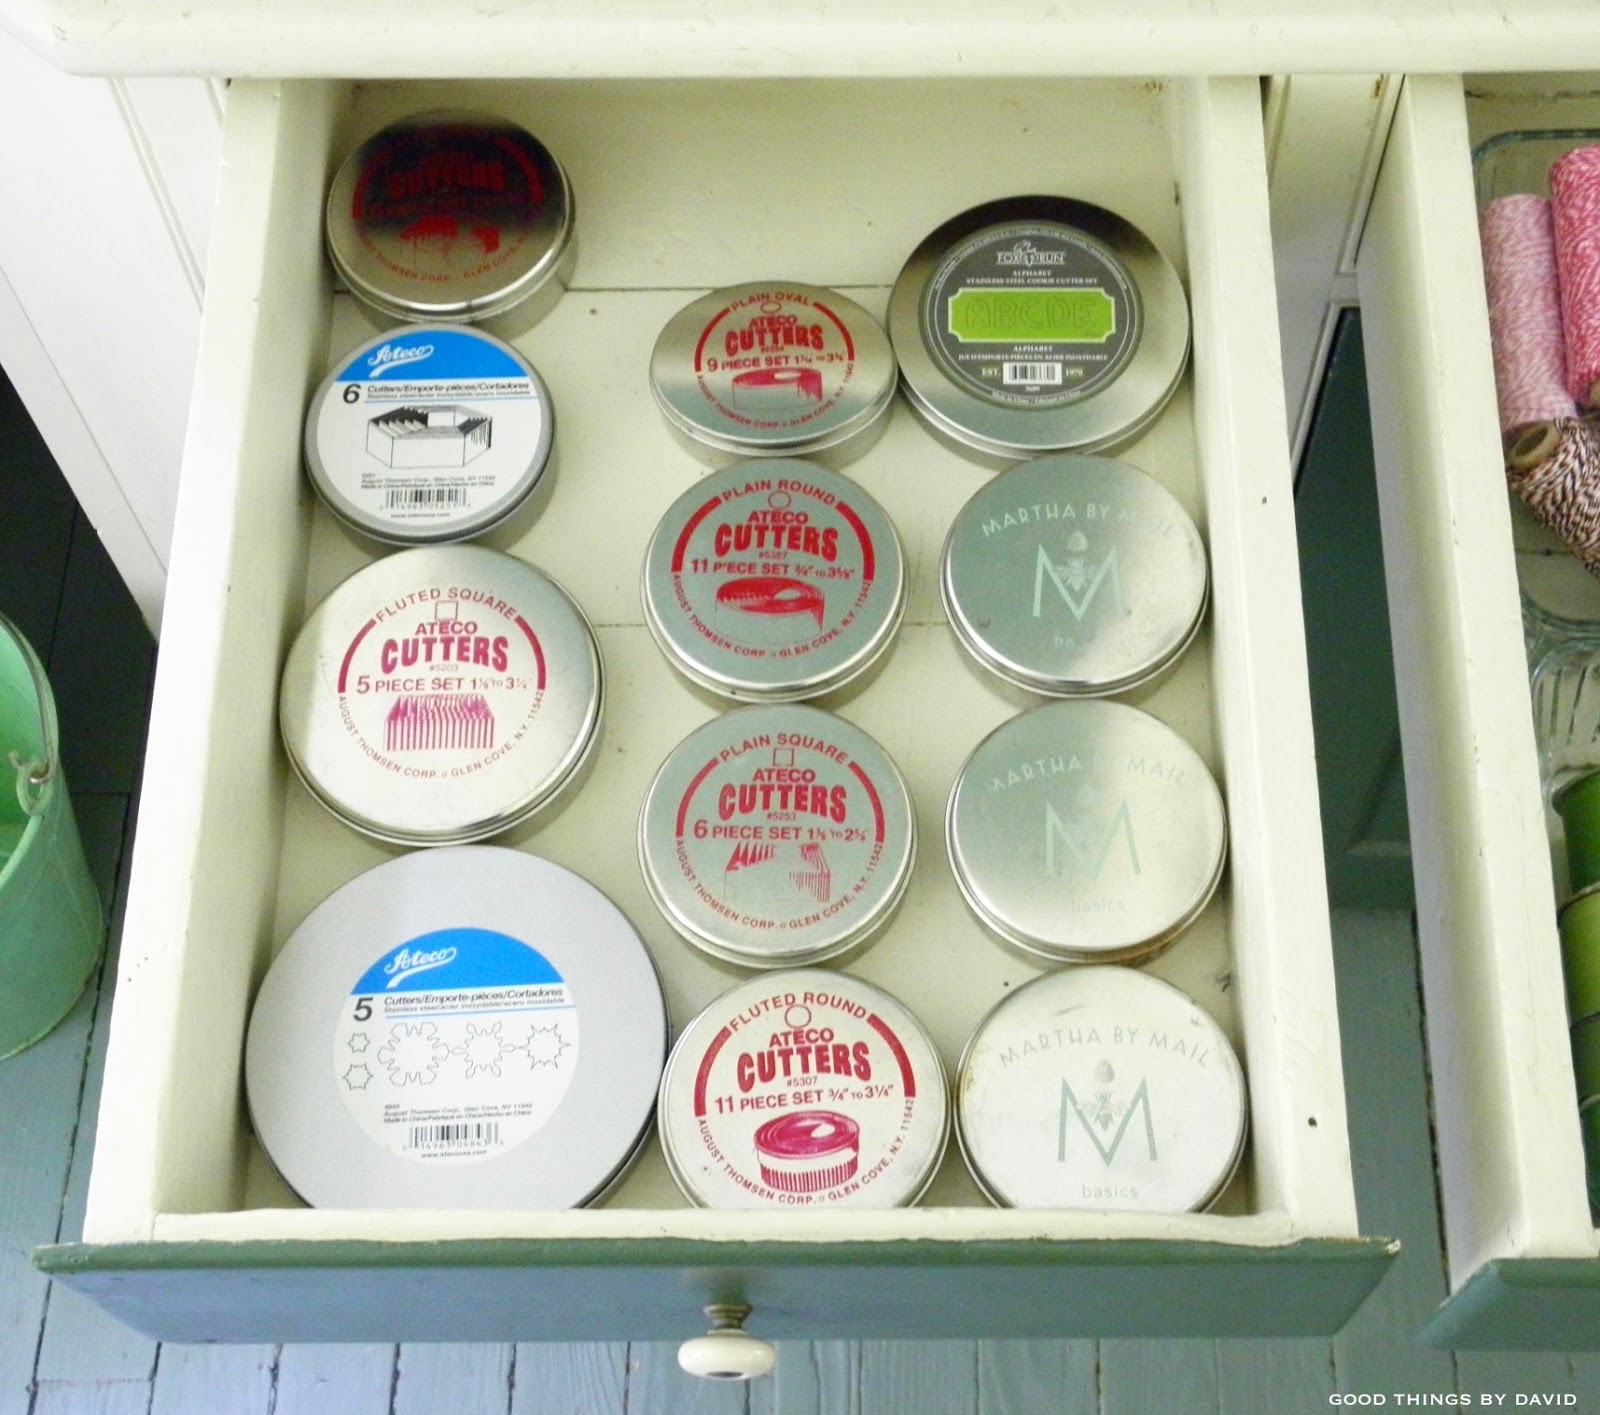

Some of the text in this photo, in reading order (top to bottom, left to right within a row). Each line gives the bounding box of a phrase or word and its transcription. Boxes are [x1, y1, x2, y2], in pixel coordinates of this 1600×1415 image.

[731, 291, 811, 311] PLAIN OVAL
[750, 314, 798, 329] ATECO
[724, 324, 825, 358] CUTTERS
[707, 357, 718, 372] 9
[721, 356, 761, 370] PIECE
[764, 355, 791, 367] SET
[343, 383, 361, 404] 6
[722, 479, 836, 505] PLAIN ROUND
[748, 510, 809, 525] ATECO
[982, 504, 1076, 538] MARTHA
[1086, 503, 1110, 519] BY
[714, 523, 838, 563] CUTTERS
[691, 558, 708, 573] 11
[761, 561, 790, 575] SET
[1032, 544, 1124, 621] M
[376, 587, 517, 623] FLUTED SQUARE
[674, 575, 692, 613] AUGUST
[689, 613, 732, 649] THOMSEN
[779, 645, 810, 658] GLEN
[414, 621, 478, 636] ATECO
[381, 636, 508, 675] CUTTERS
[429, 664, 459, 672] #5203
[356, 675, 371, 694] 5
[375, 678, 425, 693] PIECE
[431, 677, 465, 691] SET
[338, 696, 358, 737] AUGUST
[356, 734, 401, 773] THOMSEN
[451, 762, 482, 777] GLEN
[719, 733, 848, 764] PLAIN SQUARE
[752, 768, 816, 783] ATECO
[1128, 756, 1188, 786] MAIL
[718, 783, 847, 824] CUTTERS
[693, 819, 708, 839] 6
[712, 826, 763, 839] PIECE
[768, 826, 802, 840] SET
[1045, 799, 1142, 880] M
[676, 840, 696, 882] AUGUST
[694, 882, 739, 922] THOMSEN
[790, 914, 820, 929] GLEN
[353, 997, 373, 1022] 5
[730, 992, 866, 1032] FLUTED ROUND
[769, 1028, 835, 1048] ATECO
[1000, 1026, 1209, 1067] MARTHA BY MAIL
[737, 1041, 871, 1093] CUTTERS
[786, 1075, 818, 1087] #5307
[715, 1094, 734, 1114] 11
[740, 1092, 788, 1111] PIECE
[792, 1090, 824, 1105] SET
[852, 1091, 863, 1100] TO
[1058, 1076, 1158, 1168] M
[698, 1119, 723, 1163] AUGUST
[723, 1163, 774, 1201] THOMSEN
[828, 1183, 860, 1200] GLEN
[900, 1100, 914, 1132] 11542
[1082, 1184, 1138, 1199] basics
